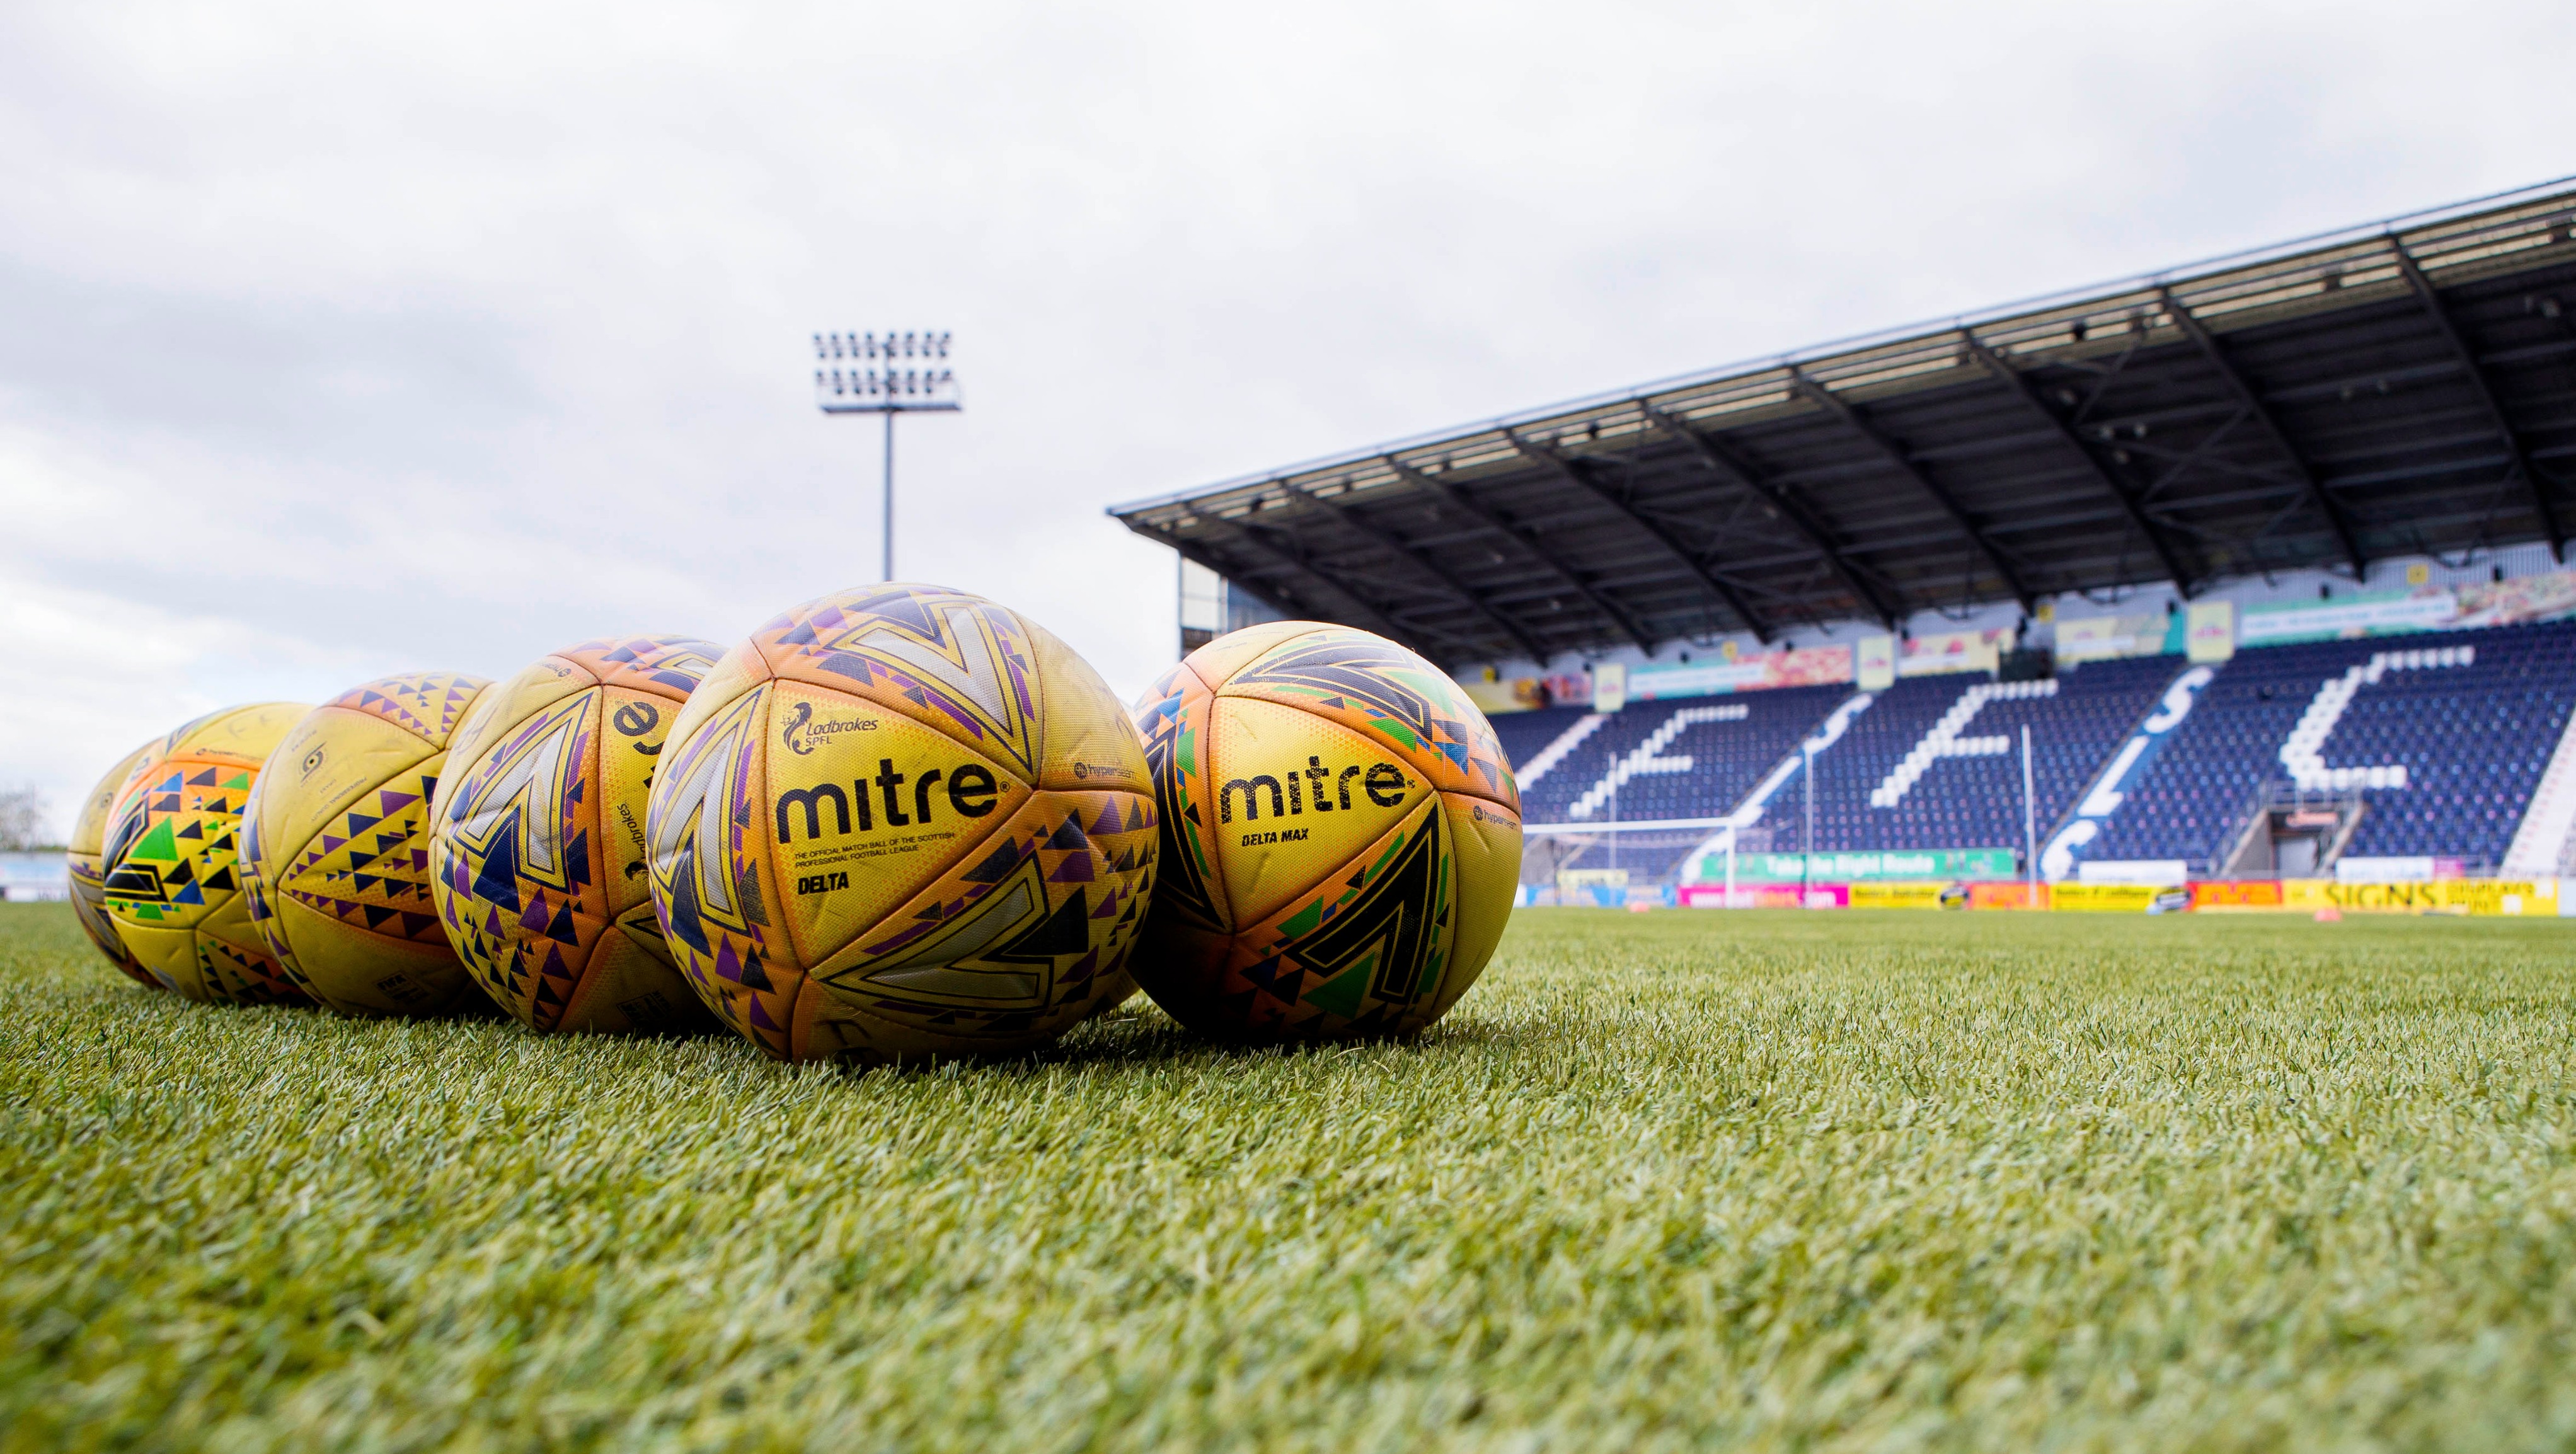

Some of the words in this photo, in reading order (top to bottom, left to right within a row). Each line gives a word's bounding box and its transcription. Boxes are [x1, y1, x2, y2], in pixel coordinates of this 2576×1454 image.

[806, 718, 878, 736] Ladbrokes
[806, 736, 832, 747] SPFL
[617, 803, 646, 859] adbrokes
[1241, 831, 1277, 846] DELTA
[1281, 828, 1309, 842] MAX
[795, 852, 807, 860] THE
[809, 848, 839, 858] OFFICIAL
[842, 843, 868, 852] MATCH
[870, 841, 887, 849] BALL
[917, 833, 955, 842] SCOTTISH
[795, 855, 848, 868] PROFESSIONAL
[850, 849, 887, 860] FOOTBALL
[890, 845, 919, 854] LEAGUE
[798, 872, 849, 895] DELTA
[2325, 882, 2437, 908] SIGNS
